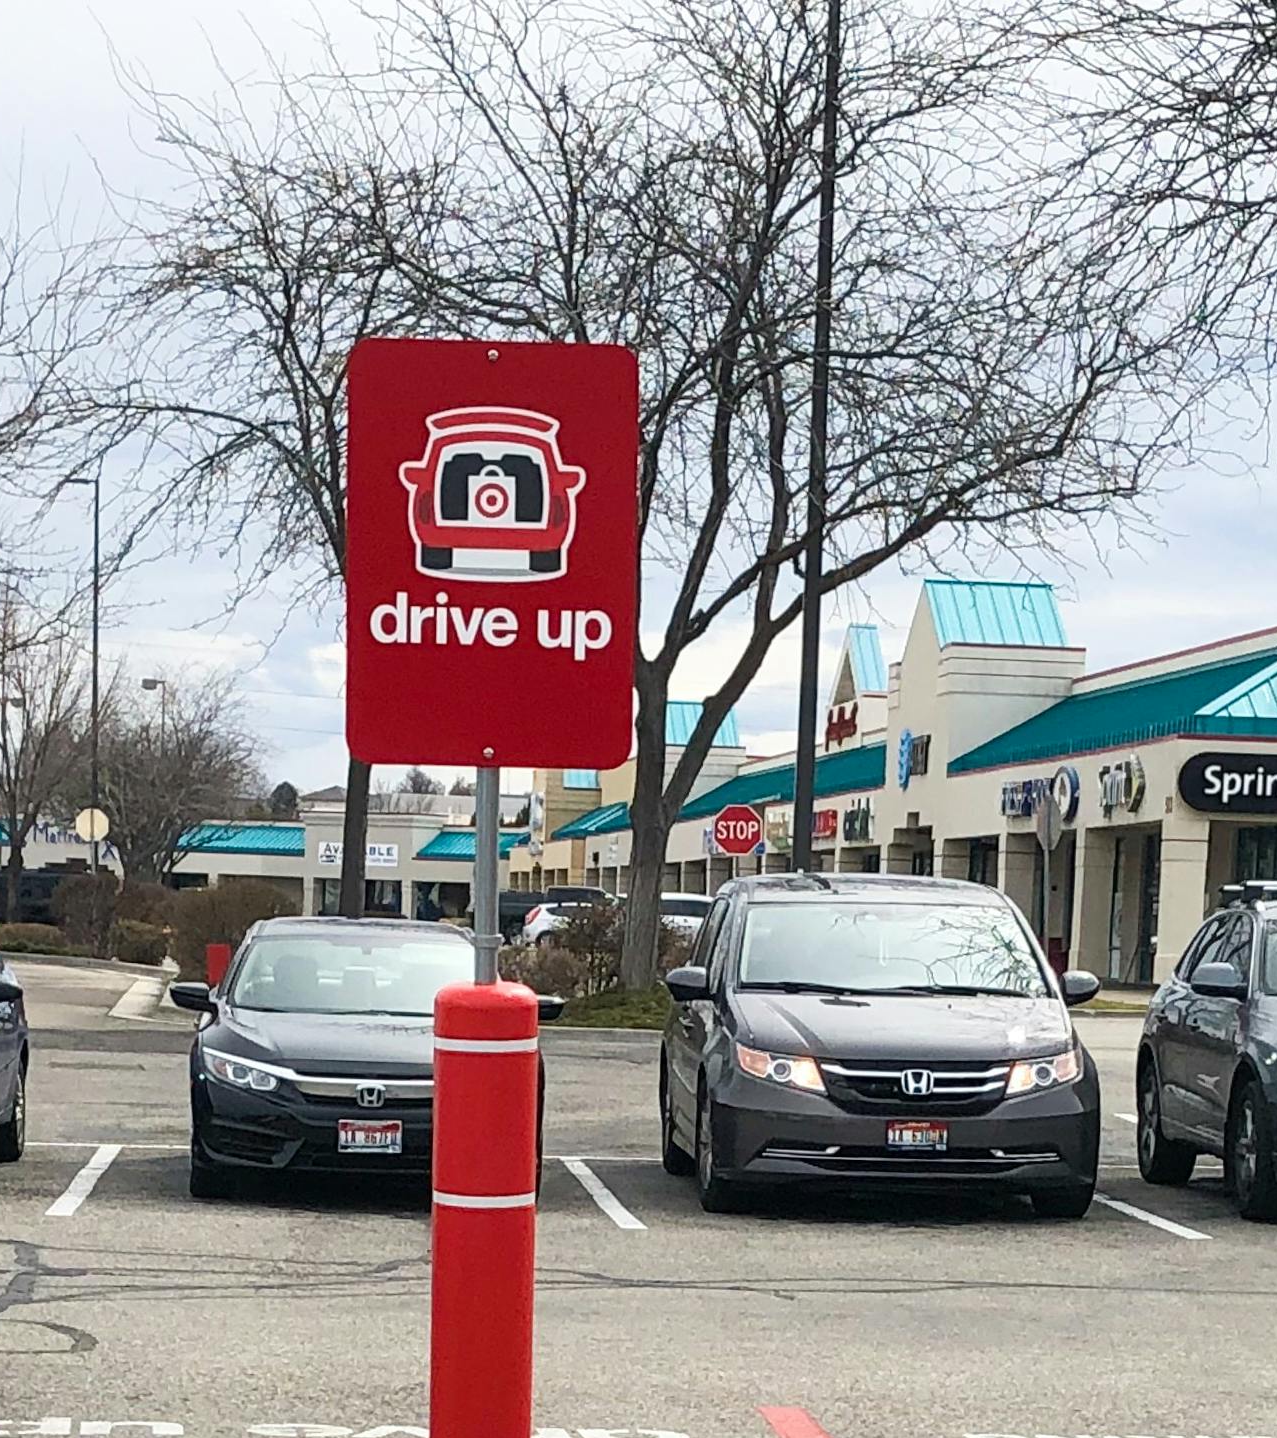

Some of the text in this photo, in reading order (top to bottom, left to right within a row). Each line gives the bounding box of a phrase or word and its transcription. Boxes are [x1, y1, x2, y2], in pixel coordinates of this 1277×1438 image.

[369, 592, 612, 661] drive up
[716, 820, 759, 840] STOP
[324, 843, 394, 856] AVBLE
